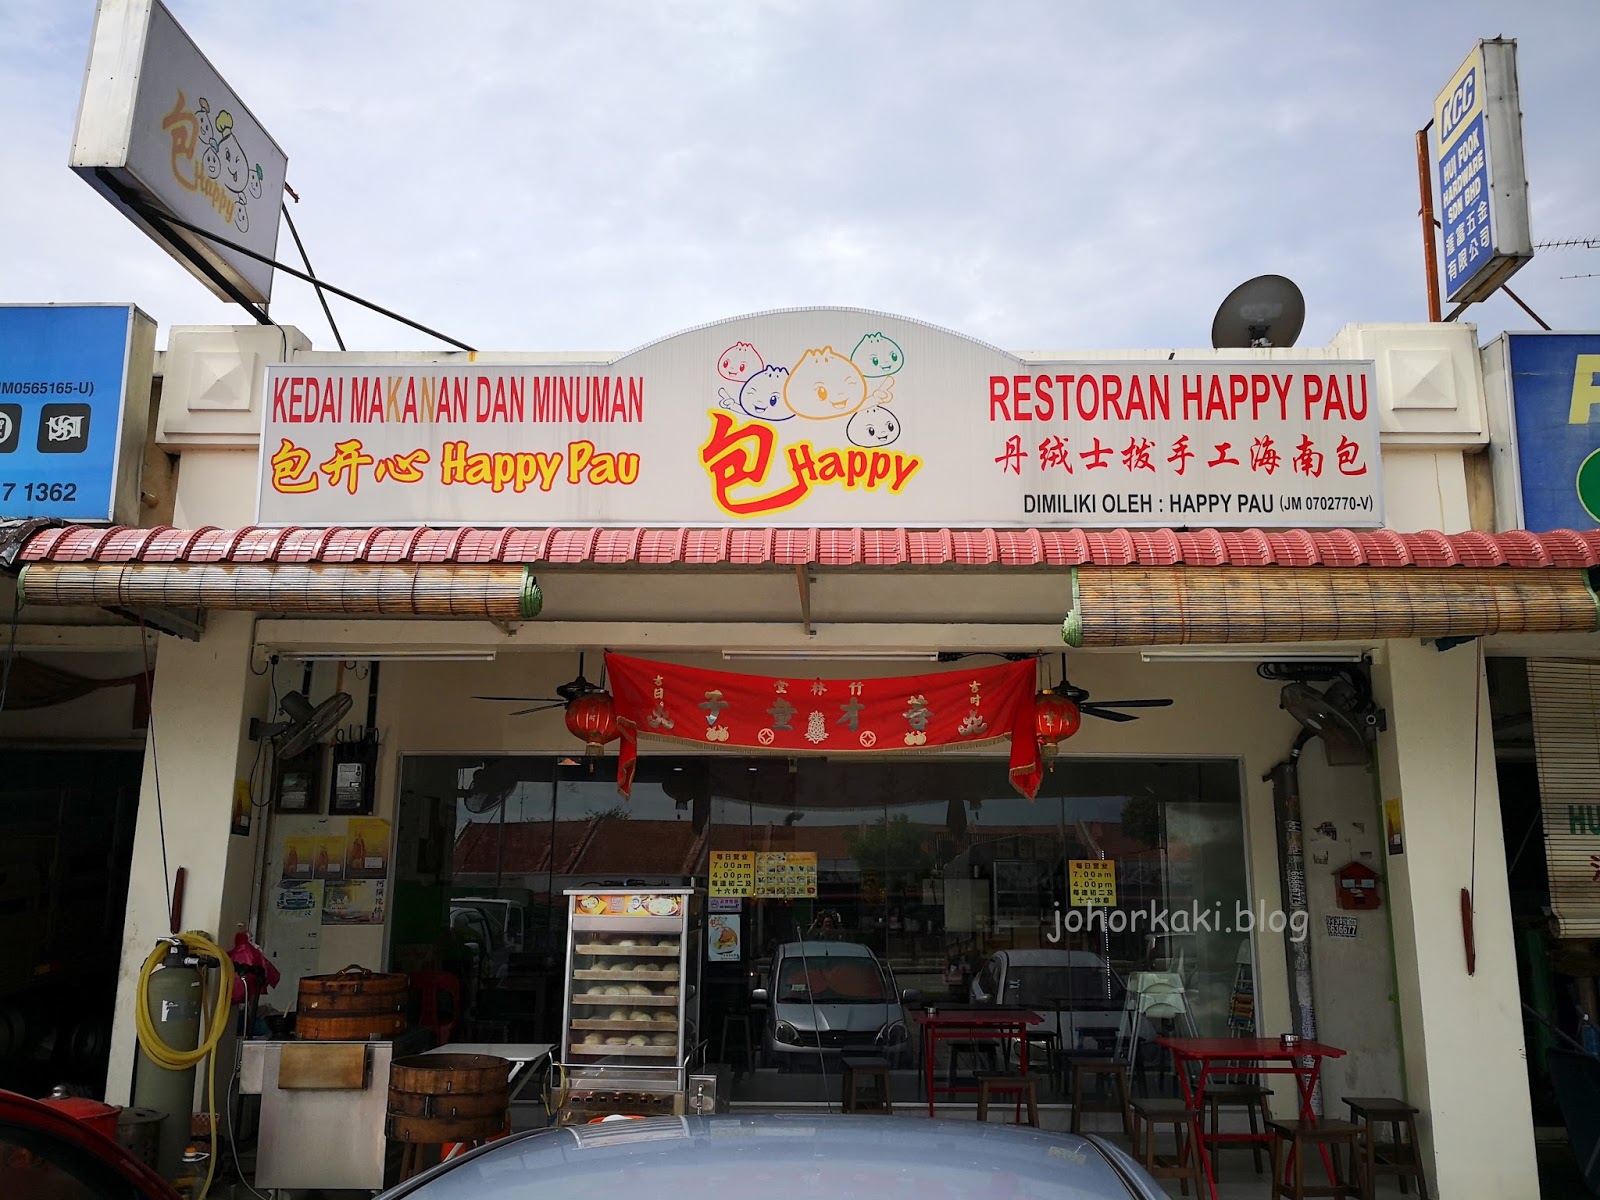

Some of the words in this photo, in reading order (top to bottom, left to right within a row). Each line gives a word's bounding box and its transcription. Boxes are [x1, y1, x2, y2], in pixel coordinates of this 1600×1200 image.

[1443, 74, 1474, 138] KCC
[162, 88, 200, 192] 包
[1444, 154, 1457, 186] HUI
[1458, 127, 1480, 168] FOOK
[194, 160, 235, 224] Happy
[1443, 149, 1484, 210] HARDWARE
[1448, 195, 1463, 225] SDN
[1464, 176, 1481, 207] BHD
[1448, 225, 1490, 282] 有限公司
[0, 382, 95, 396] M0565165-U)
[272, 377, 343, 423] KEDAI
[350, 376, 468, 423] MAKANAN
[476, 376, 525, 423] DAN
[533, 376, 644, 424] MINUMAN
[989, 374, 1170, 421] RESTORAN
[1182, 374, 1293, 421] HAPPY
[1303, 374, 1368, 421] PAU
[271, 438, 430, 495] 包开心
[441, 440, 563, 493] Happy
[567, 440, 640, 485] Pau
[700, 409, 810, 518] 包
[786, 442, 922, 495] Happy
[24, 483, 77, 502] 1362
[1024, 494, 1096, 513] DIMILIKI
[1102, 494, 1152, 513] OLEH
[1169, 494, 1232, 513] HAPPY
[1238, 494, 1273, 513] PAU
[1280, 494, 1301, 512] (JM
[1305, 495, 1373, 512] 0702770-V)
